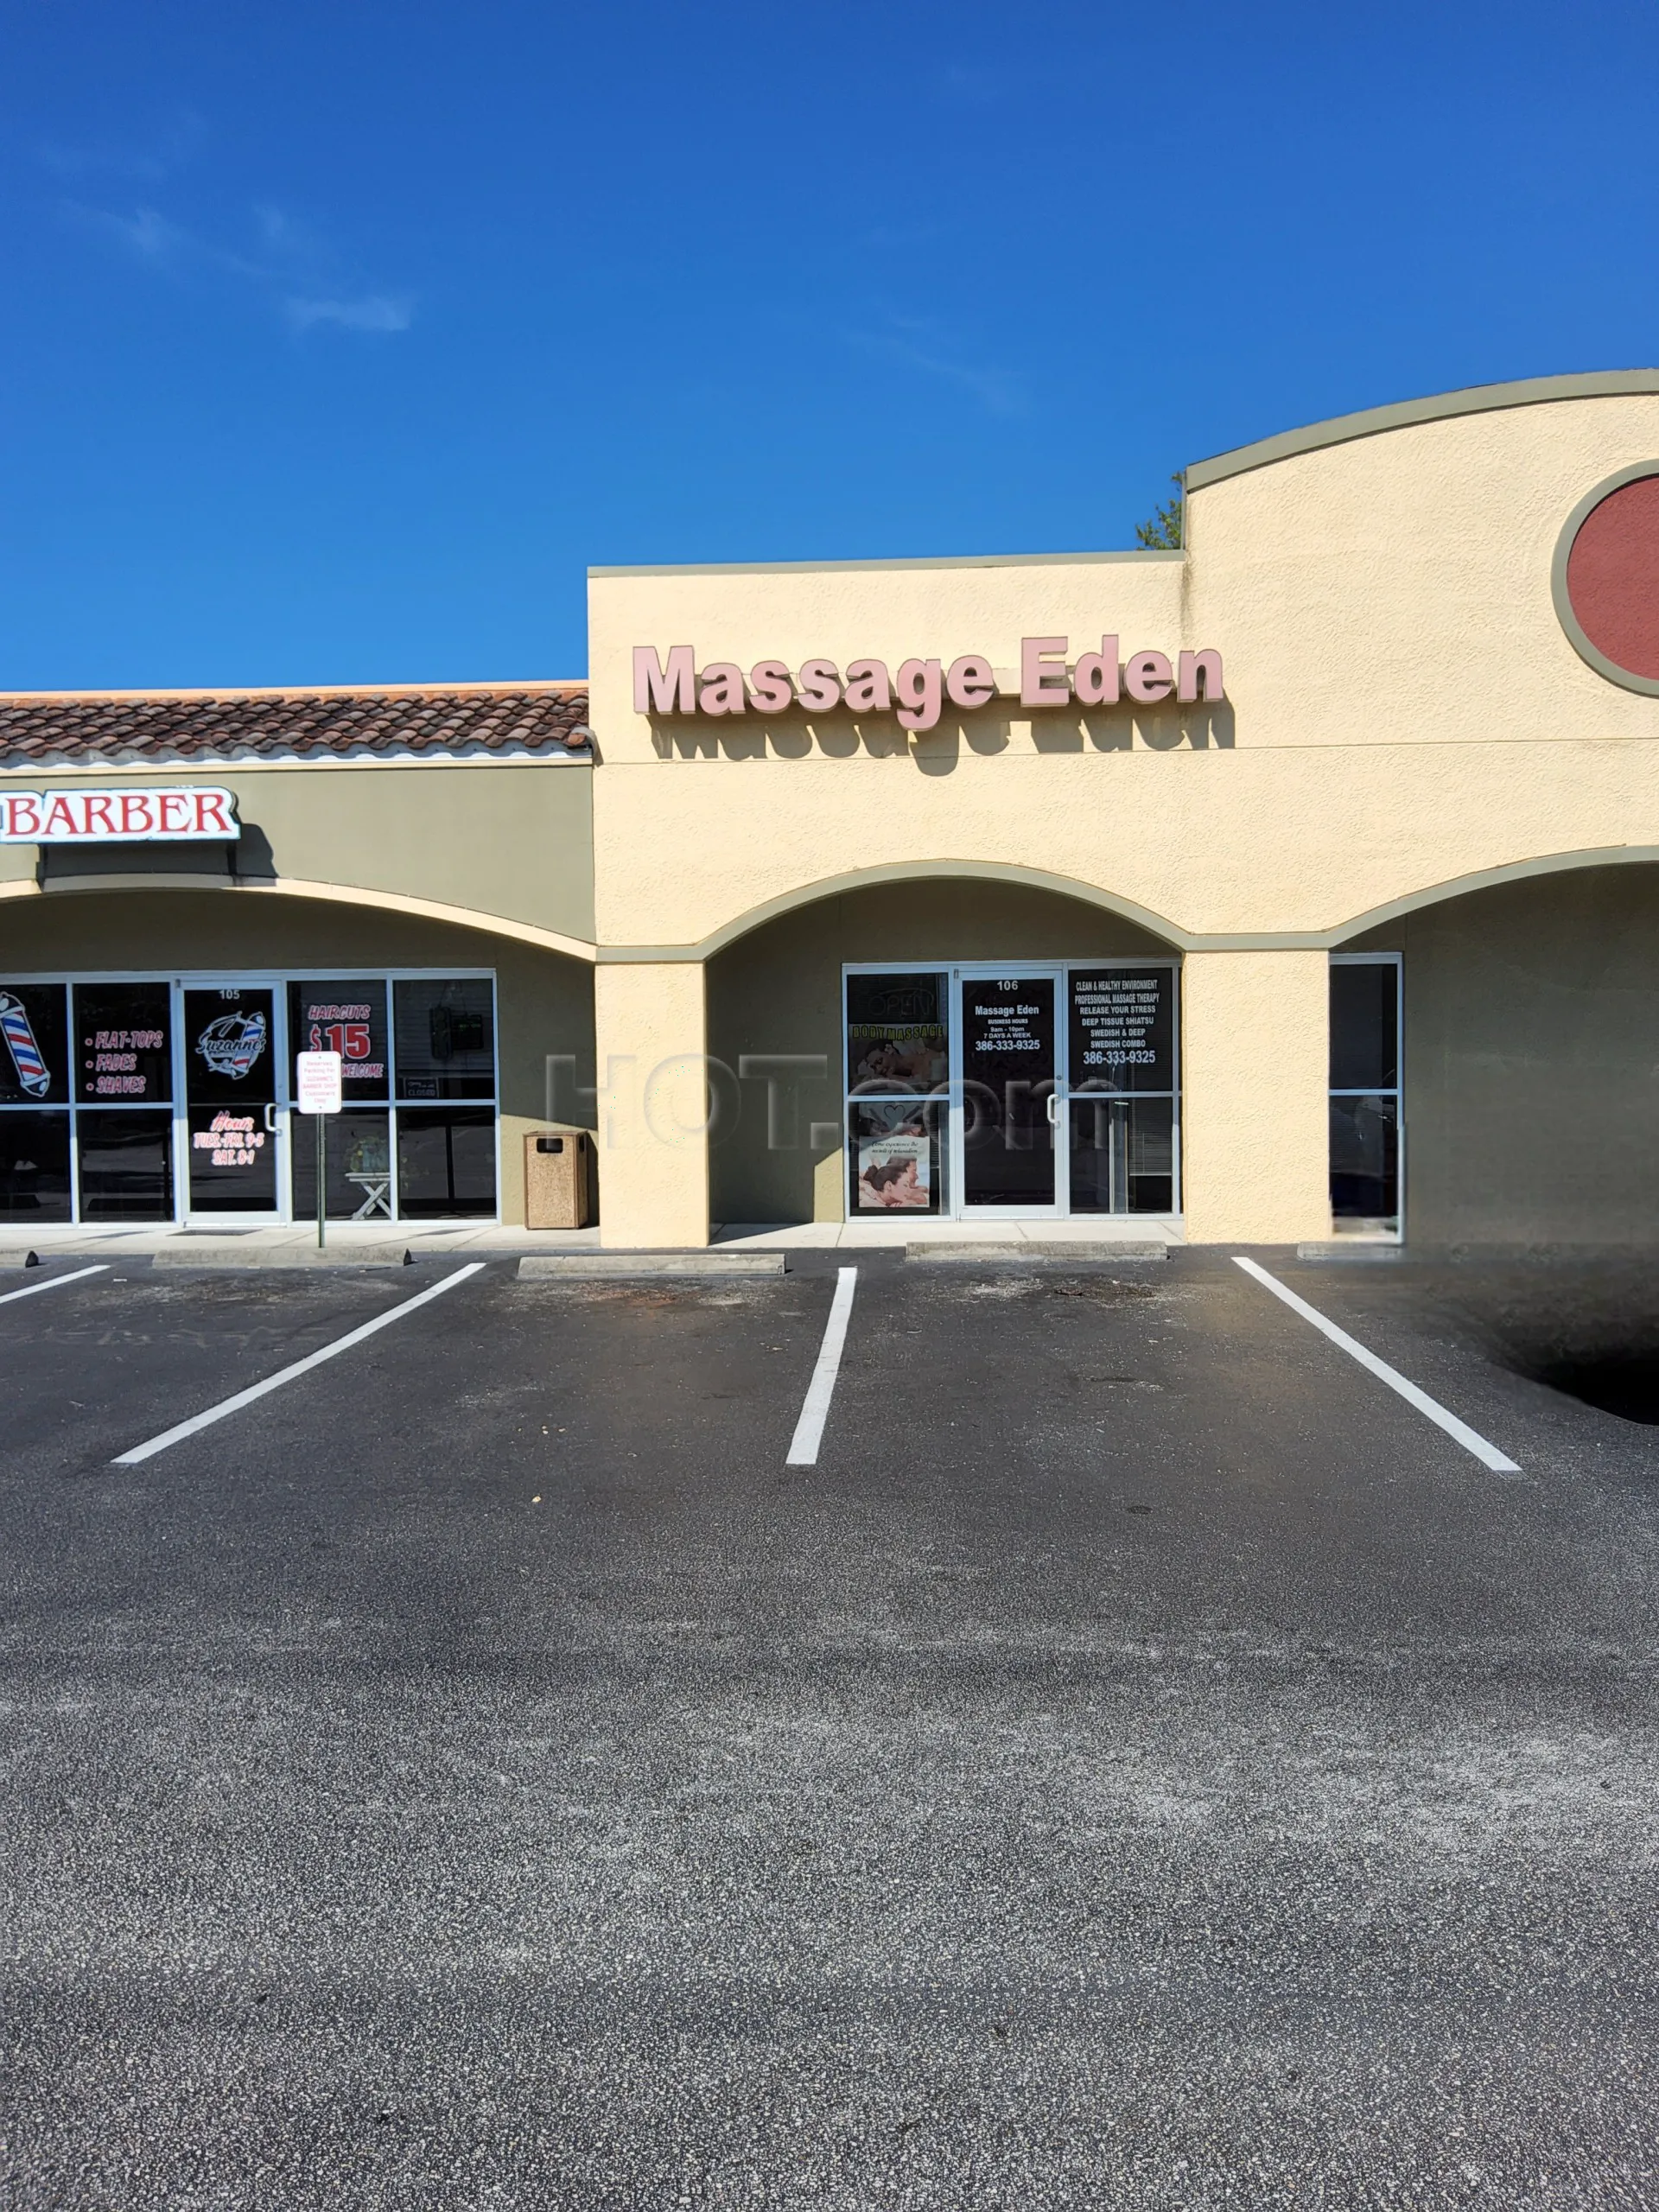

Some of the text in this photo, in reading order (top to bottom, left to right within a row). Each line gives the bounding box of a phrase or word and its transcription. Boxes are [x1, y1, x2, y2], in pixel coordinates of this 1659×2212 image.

[632, 634, 1224, 732] Massage Eden
[5, 794, 232, 836] BARBER
[997, 980, 1019, 991] 106
[1076, 979, 1158, 992] CLEAN & HEALTHY ENVIRONMENT
[219, 989, 240, 1000] 105
[1075, 992, 1160, 1005] PROFESSIONAL MASSAGE THERAPY
[308, 1004, 372, 1020] HAIRCUTS
[868, 994, 931, 1017] OPEN
[975, 1004, 1039, 1017] Massage Eden
[1079, 1005, 1156, 1014] RELEASE YOUR STRESS
[1082, 1016, 1154, 1027] DEEP TISSUE SHIATSU
[852, 1024, 944, 1041] BODY MASSAGE
[1090, 1028, 1121, 1037] SWEDISH
[1128, 1027, 1146, 1036] DEEP
[95, 1031, 163, 1049] FLAT-TOPS
[975, 1039, 1040, 1052] 386-333-9325
[1090, 1039, 1146, 1048] SWEDISH COMBO
[95, 1053, 137, 1071] FADES
[1083, 1050, 1156, 1065] 386-333-9325
[341, 1063, 385, 1078] WELCOME
[96, 1077, 146, 1094] SHAVES
[210, 1110, 255, 1132] Hours
